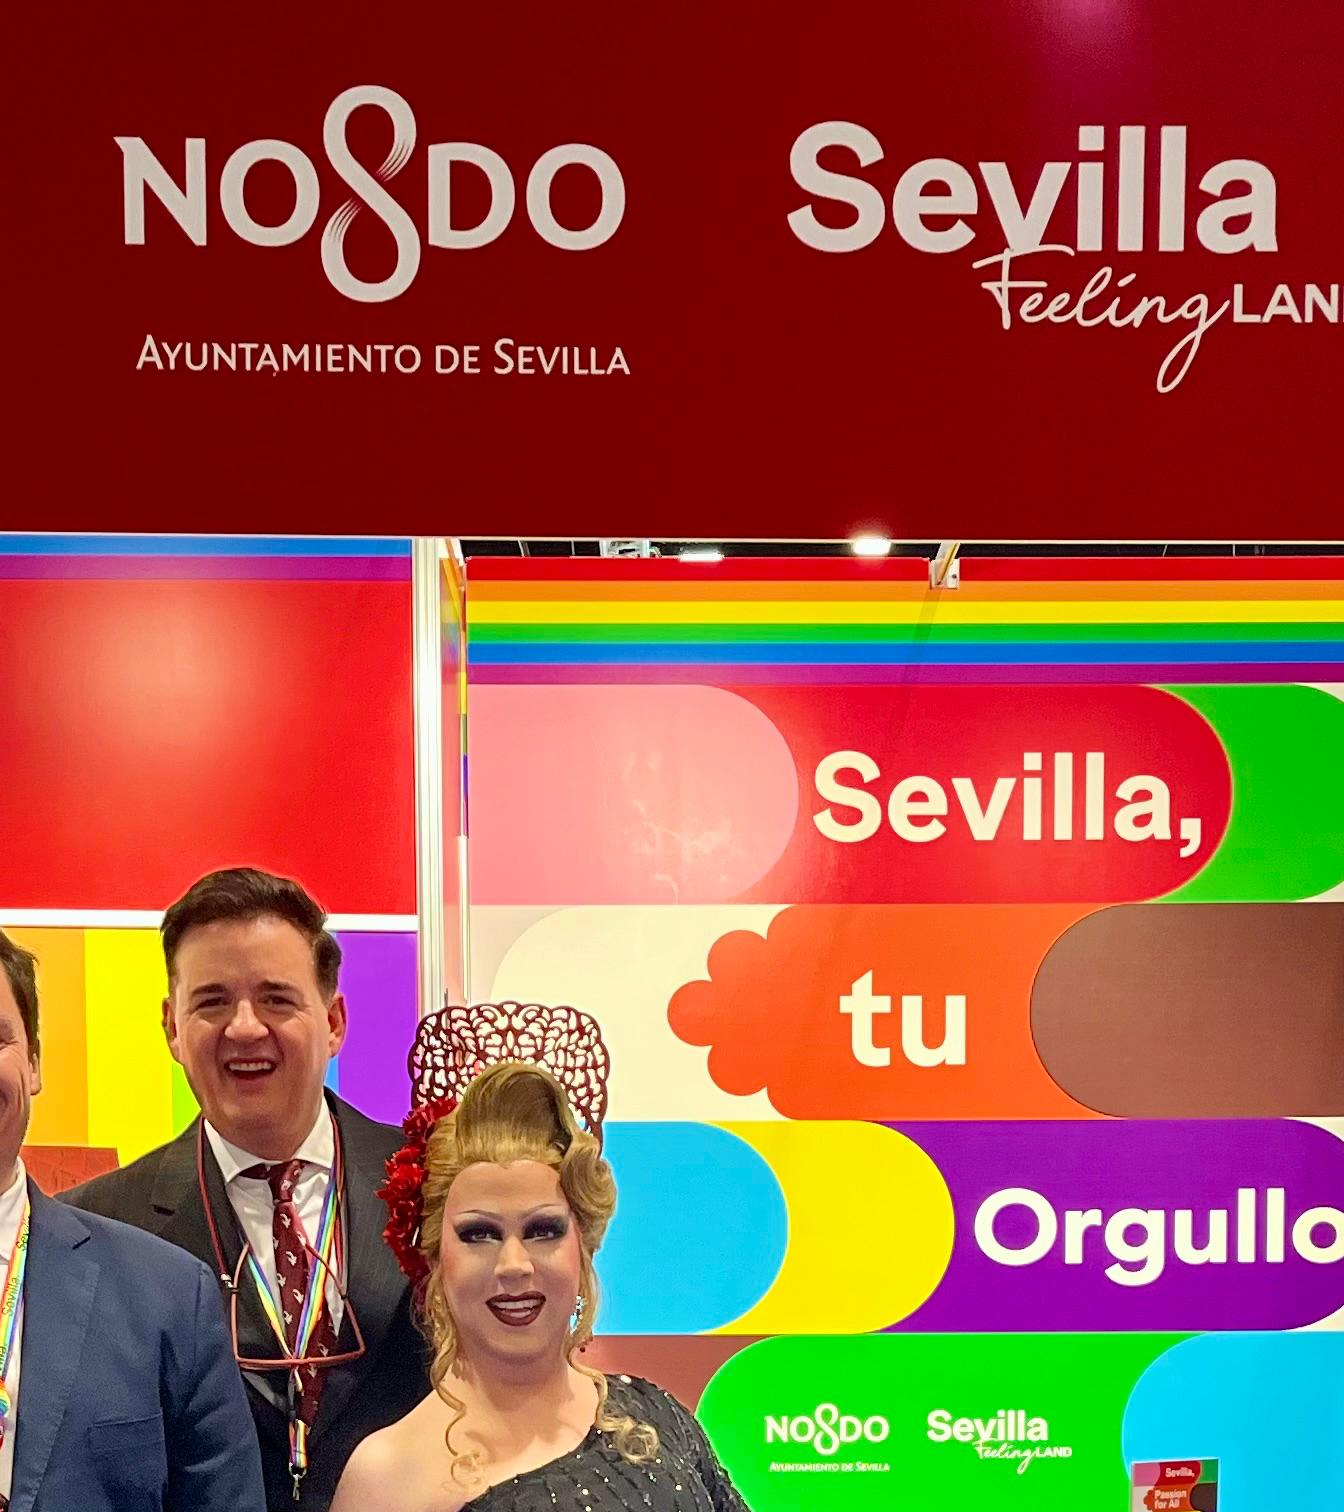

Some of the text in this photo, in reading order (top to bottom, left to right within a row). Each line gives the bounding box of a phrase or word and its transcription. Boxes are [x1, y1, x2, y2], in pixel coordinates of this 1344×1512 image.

[786, 121, 1278, 254] Sevilla
[135, 333, 631, 375] AYUNTAMIENTO DE SEVILLA
[812, 750, 1202, 858] Sevilla,
[839, 969, 966, 1067] tu
[927, 1409, 1048, 1441] Sevilla
[770, 1461, 890, 1472] AYUNTAMIENTO DE SEVILLA
[1155, 1489, 1187, 1499] Passion
